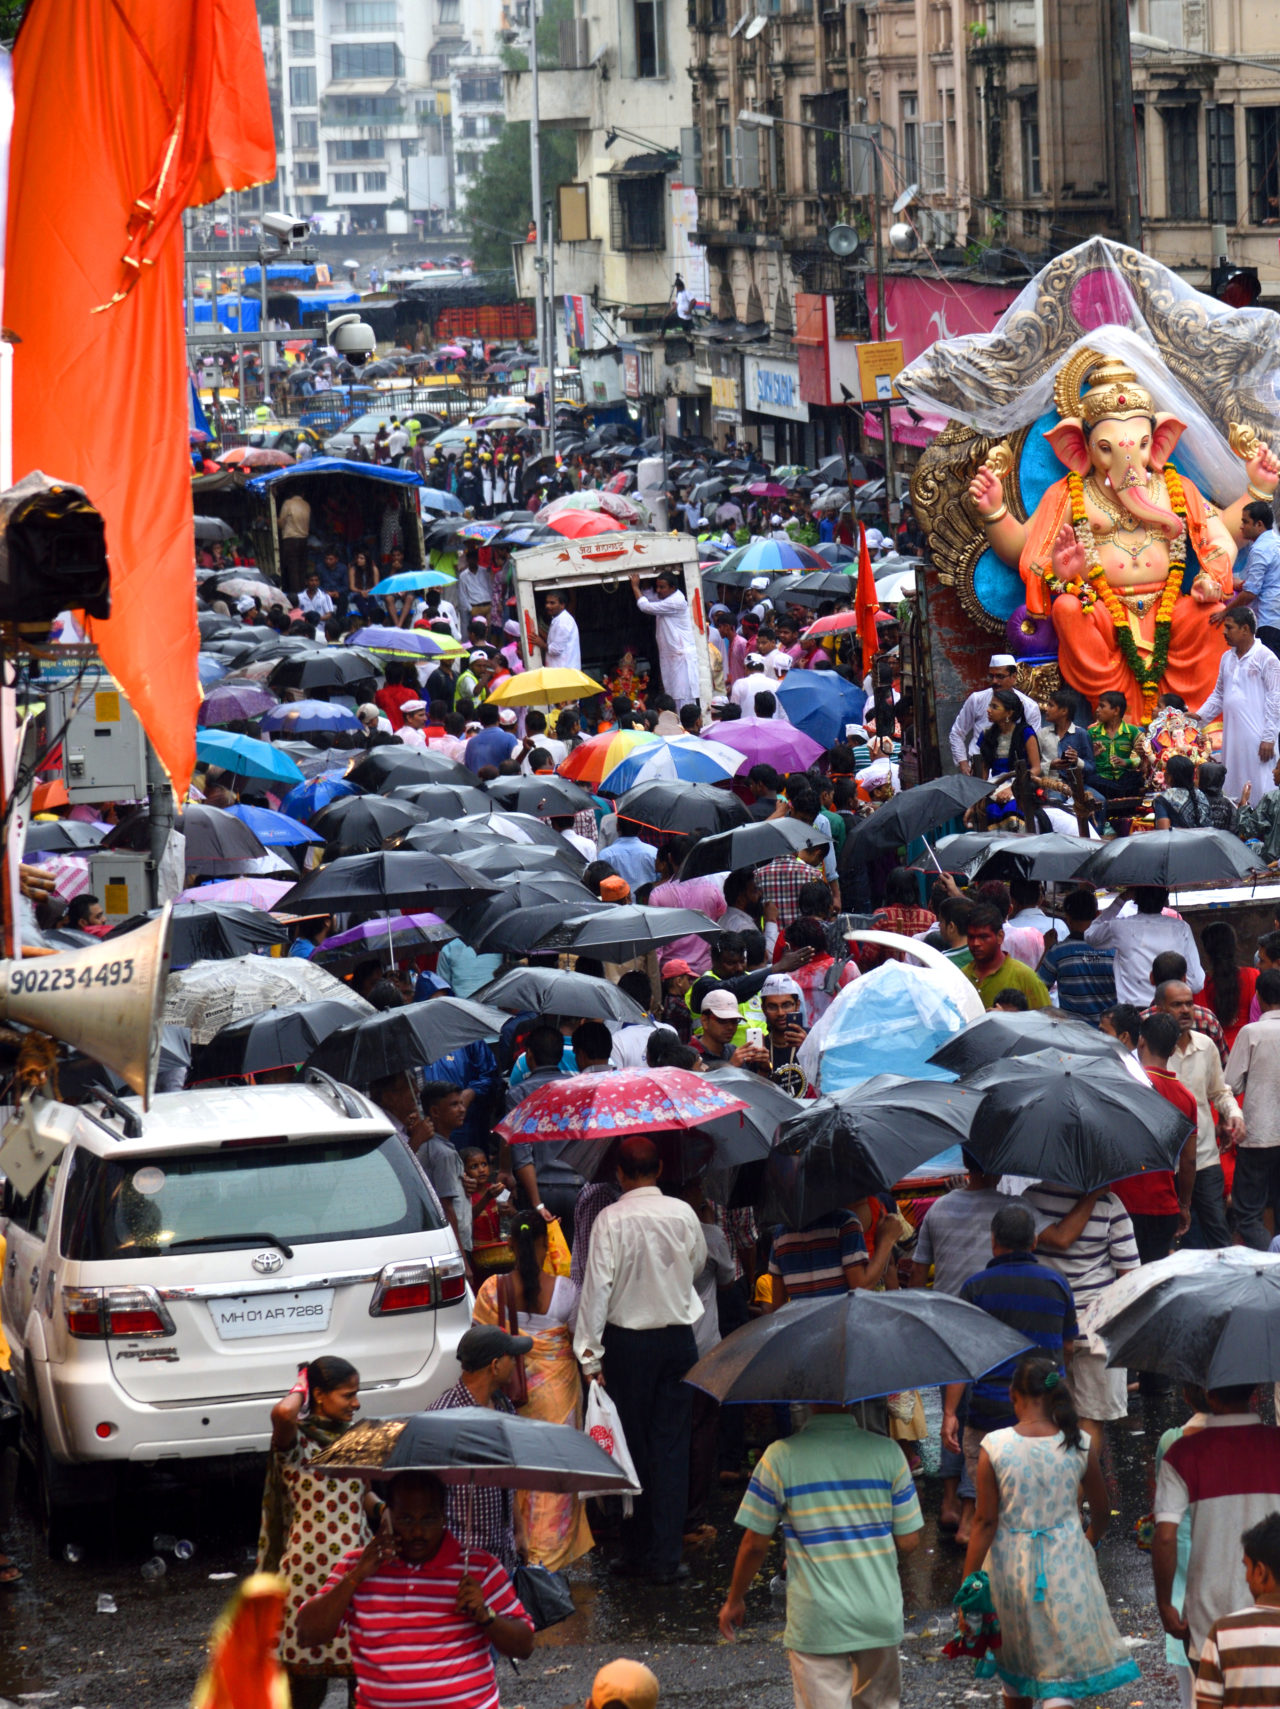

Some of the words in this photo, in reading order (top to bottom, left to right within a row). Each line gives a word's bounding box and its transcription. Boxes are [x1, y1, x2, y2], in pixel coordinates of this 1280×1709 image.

[579, 545, 592, 555] जय
[10, 959, 134, 995] 902234493
[221, 1312, 244, 1323] MH
[248, 1311, 263, 1322] 01
[265, 1308, 285, 1319] AR
[288, 1304, 324, 1318] 7268
